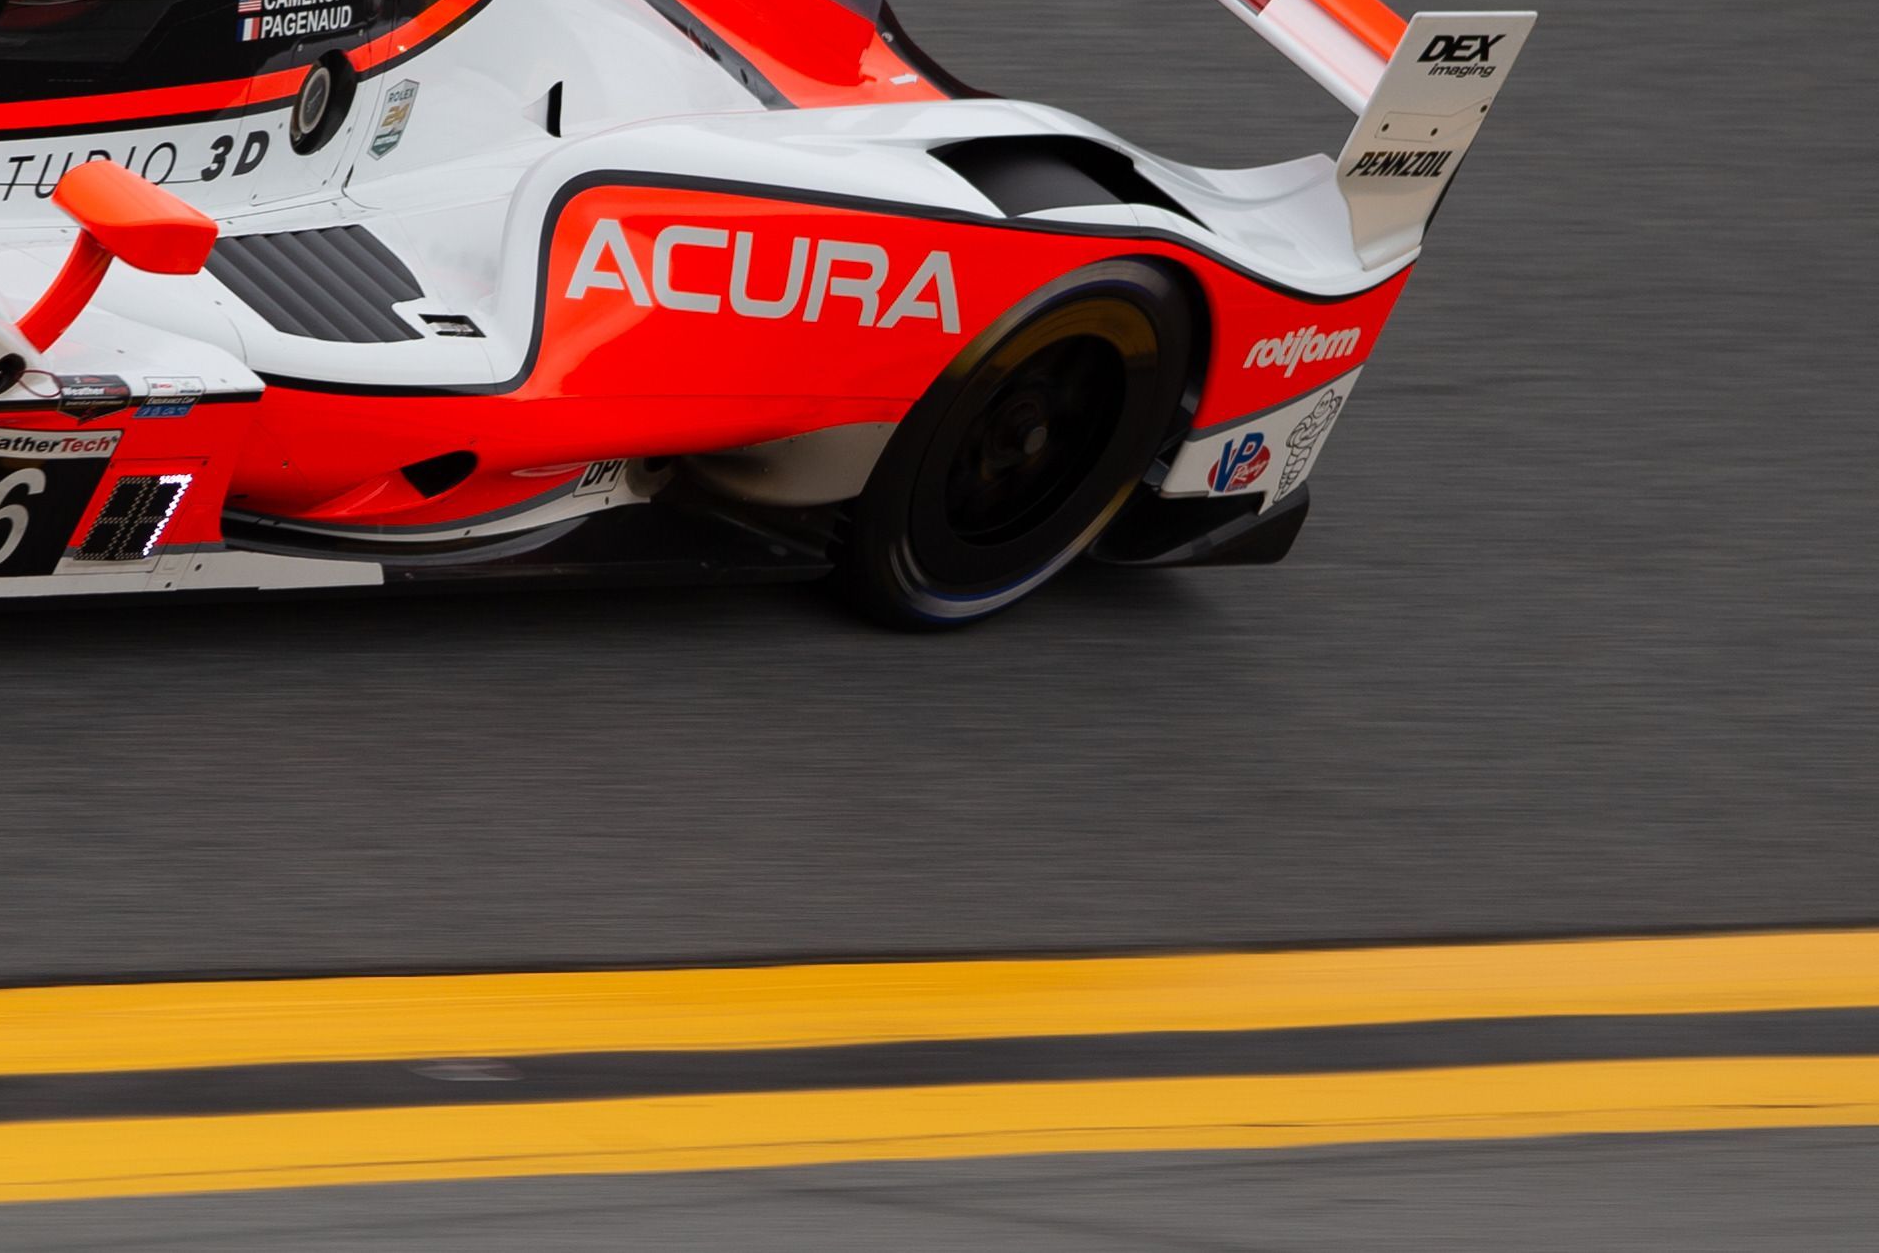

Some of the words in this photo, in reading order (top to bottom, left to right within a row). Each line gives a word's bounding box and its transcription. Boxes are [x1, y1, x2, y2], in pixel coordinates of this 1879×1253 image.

[260, 5, 352, 39] PAGENAUD
[1417, 34, 1506, 62] DEX
[1428, 63, 1496, 78] imaging
[201, 130, 270, 182] 3D
[1346, 151, 1453, 177] PENNZOIL
[565, 218, 961, 334] ACURA
[1243, 325, 1361, 378] rotiform
[1214, 431, 1264, 492] VP
